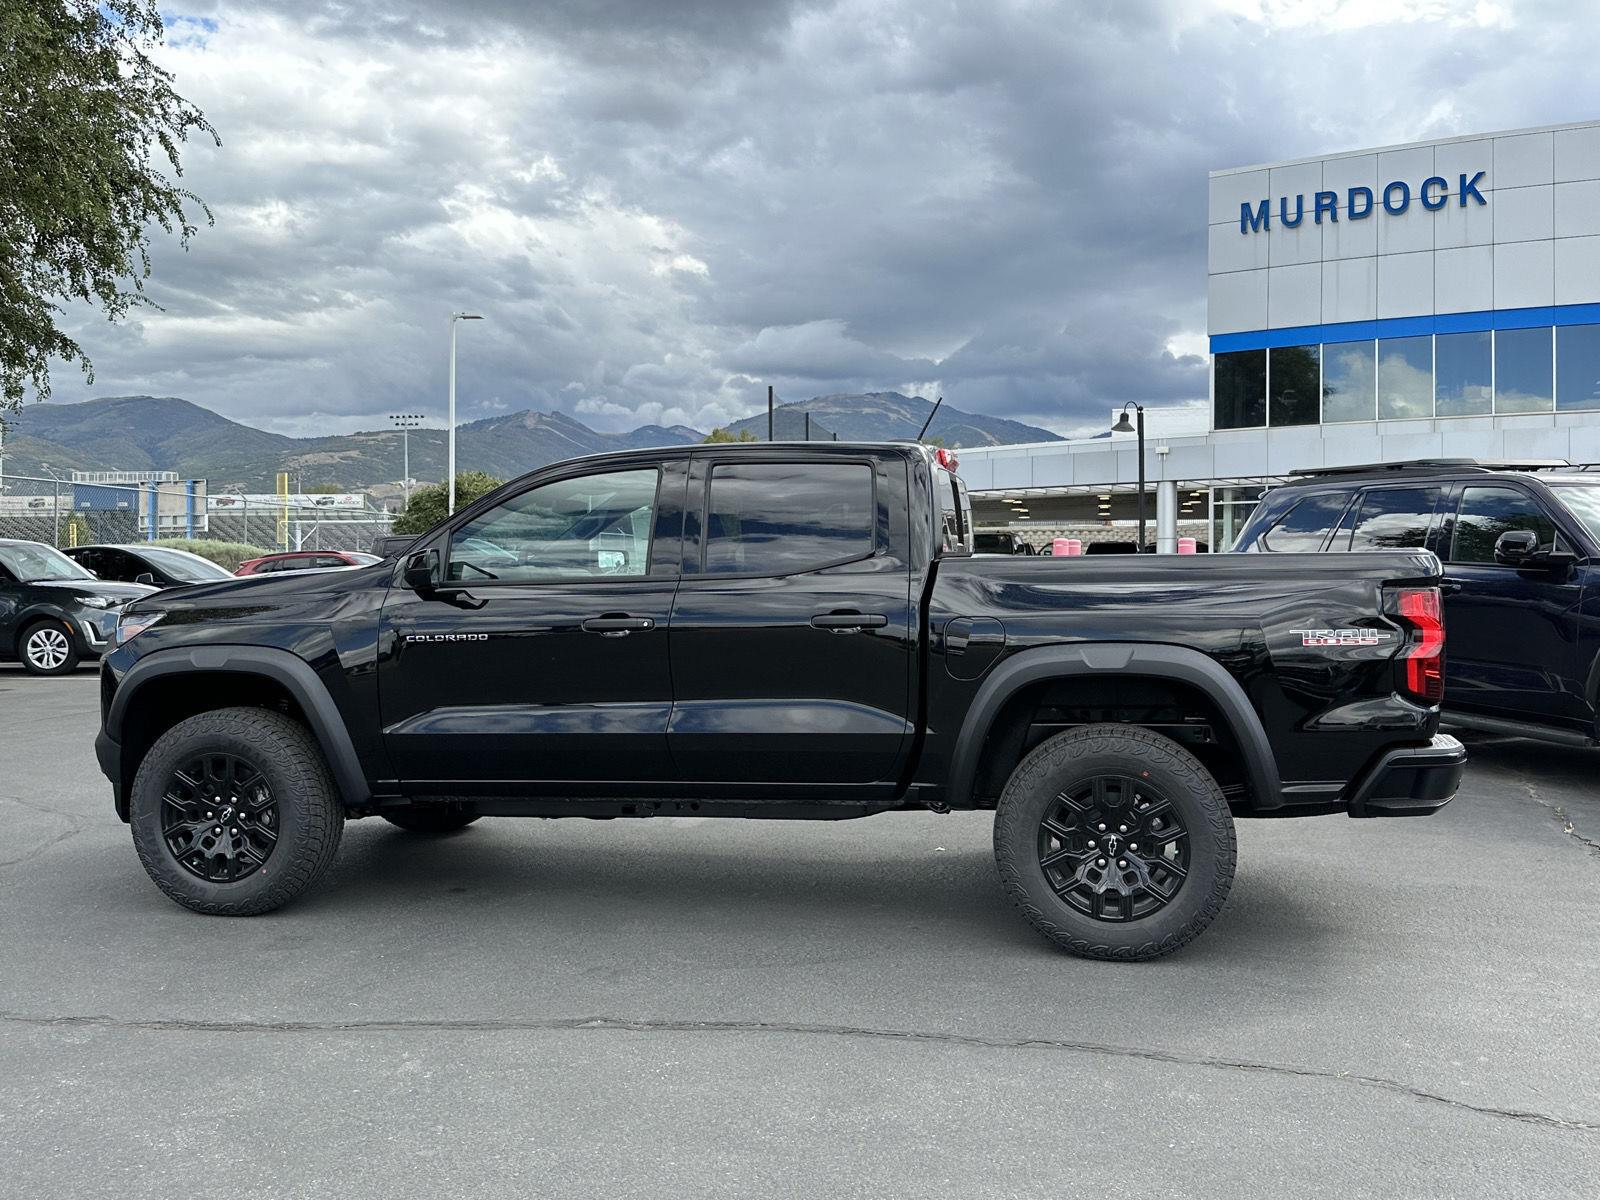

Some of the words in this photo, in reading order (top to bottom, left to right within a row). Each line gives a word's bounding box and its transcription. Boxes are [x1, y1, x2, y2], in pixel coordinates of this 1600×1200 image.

[1240, 171, 1487, 235] MURDOCK
[406, 634, 488, 642] COLORADO
[1289, 628, 1391, 639] TRAIL
[1302, 637, 1379, 646] BOSS
